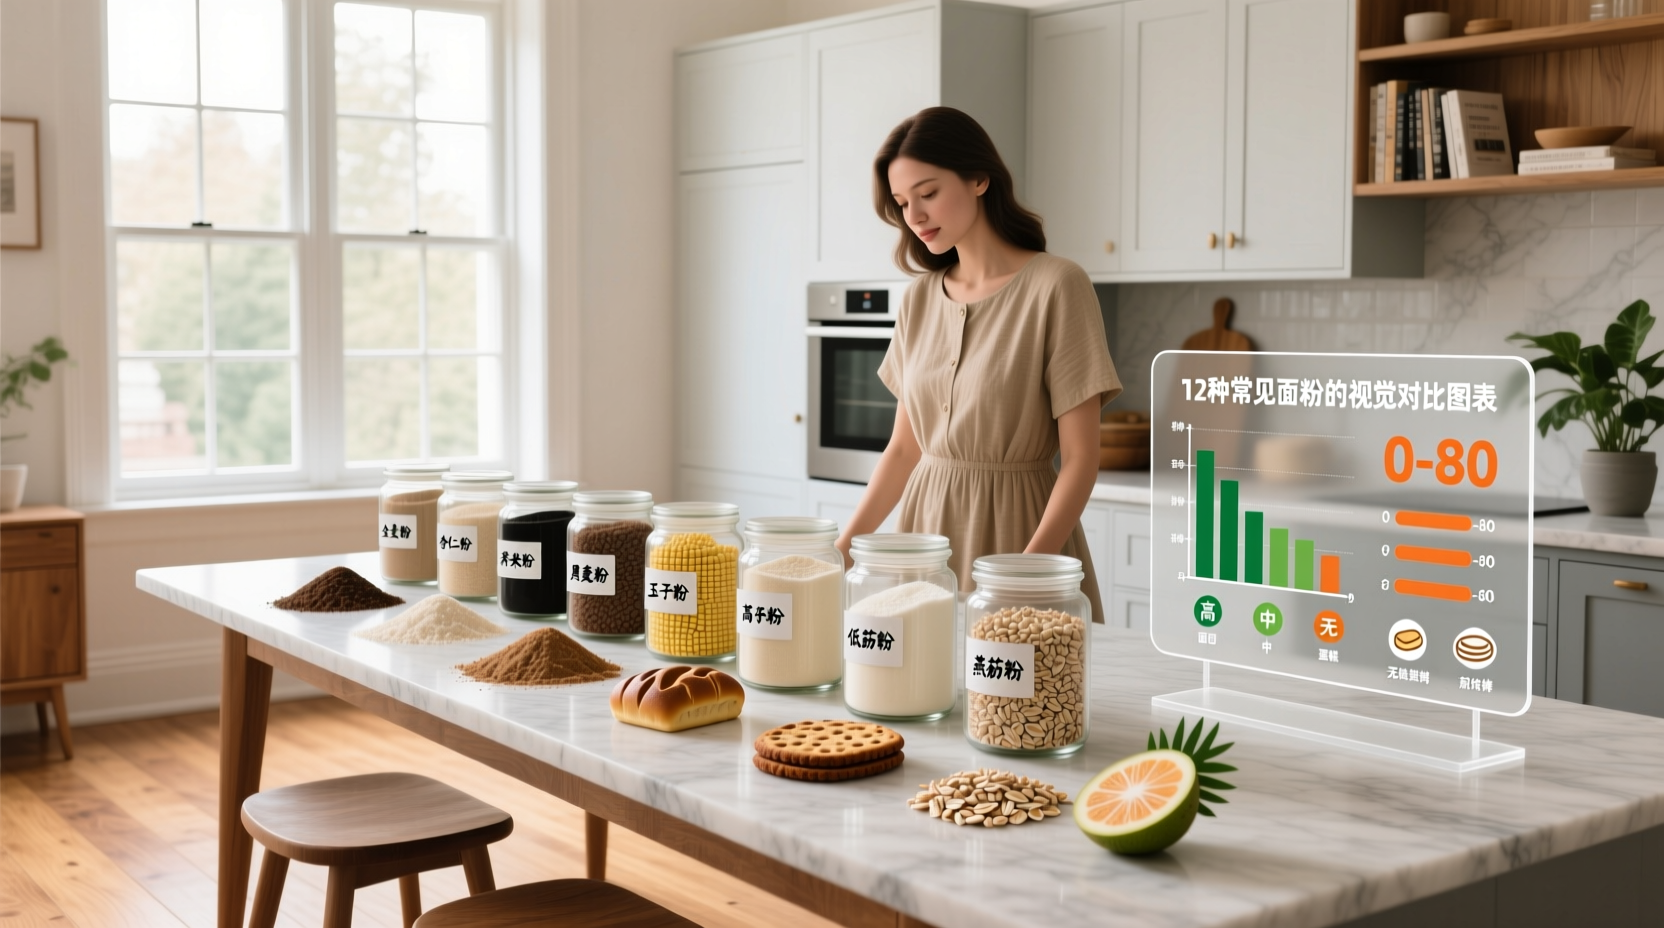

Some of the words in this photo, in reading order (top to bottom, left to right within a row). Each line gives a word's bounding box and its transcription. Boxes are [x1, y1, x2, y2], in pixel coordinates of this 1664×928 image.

[1181, 375, 1498, 413] 12种常见面粉的视觉对比图表
[1383, 435, 1498, 489] 0-80
[1382, 510, 1390, 523] 0
[1200, 600, 1216, 622] 高
[1260, 608, 1276, 630] 中
[1319, 617, 1338, 637] 无
[1262, 638, 1272, 655] 中
